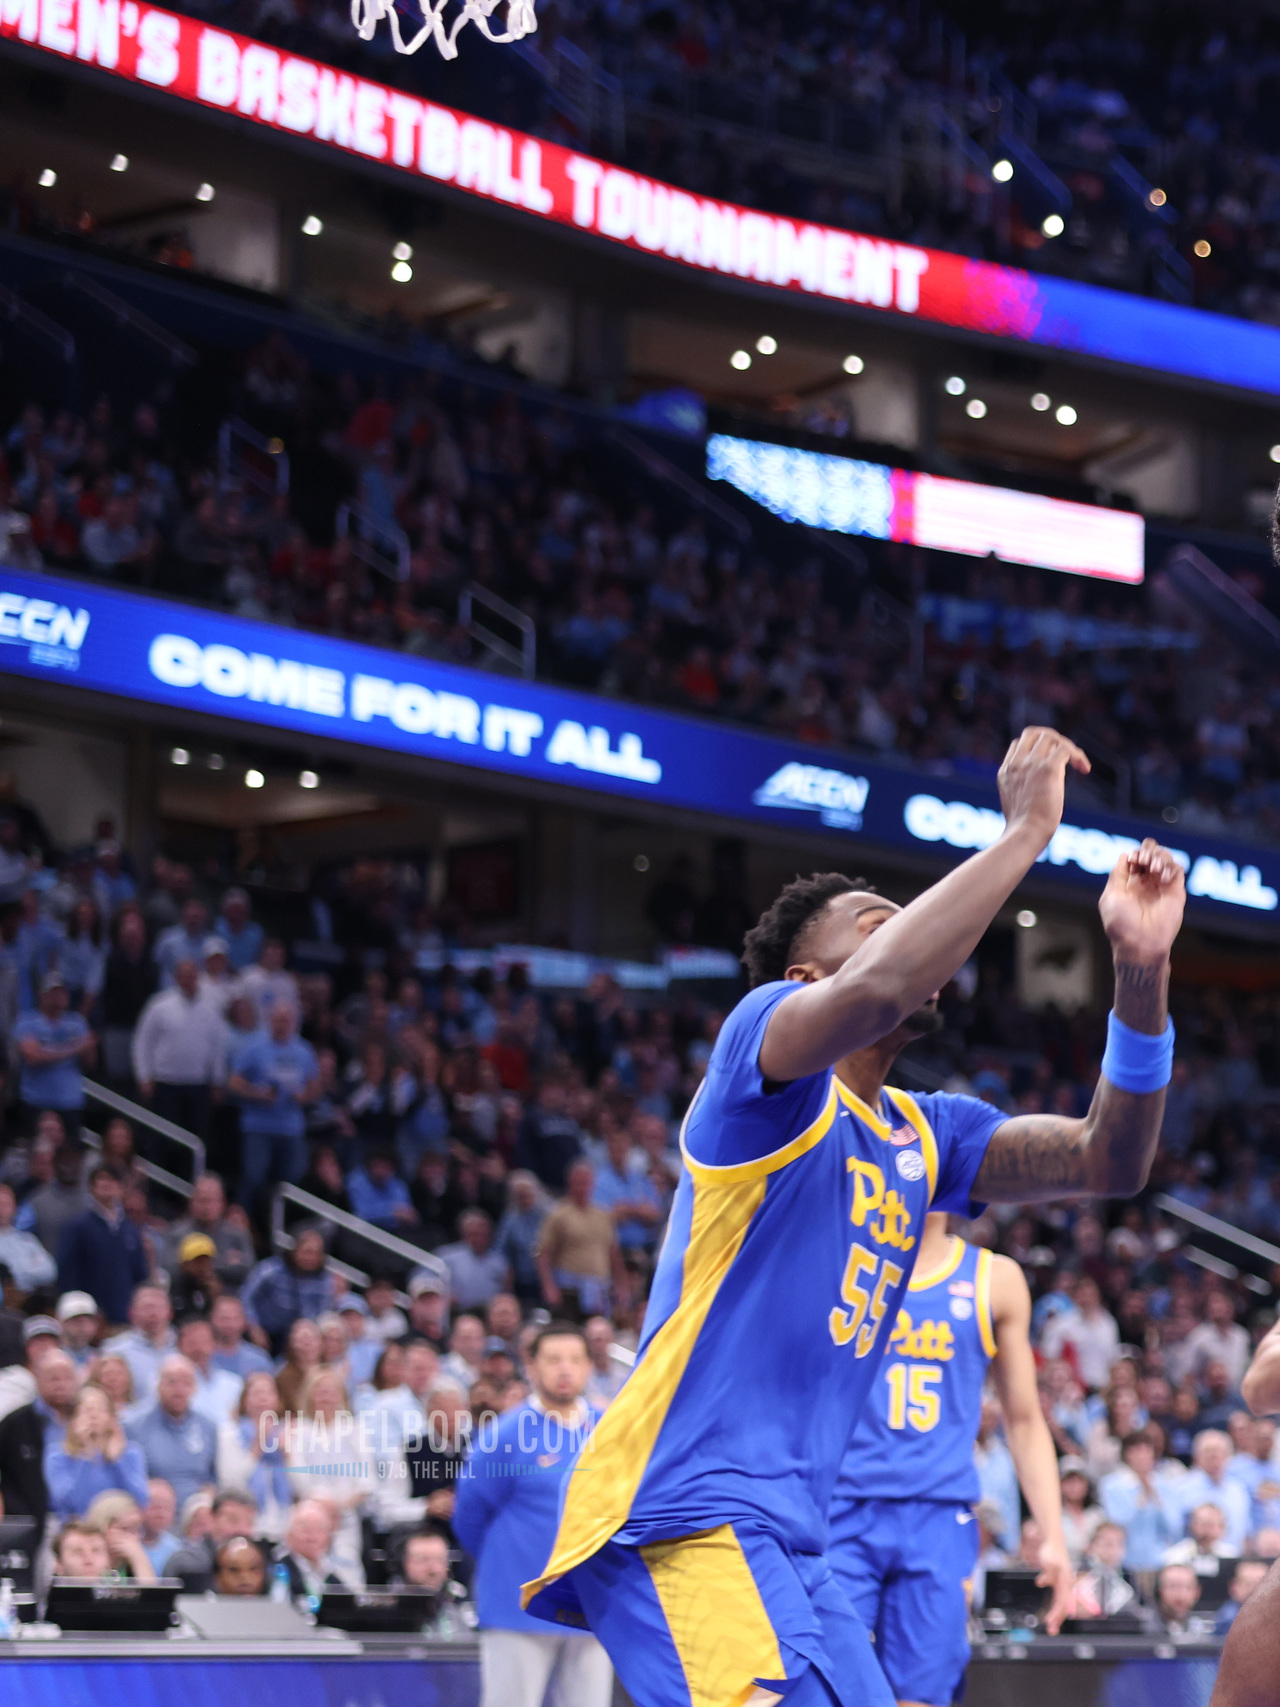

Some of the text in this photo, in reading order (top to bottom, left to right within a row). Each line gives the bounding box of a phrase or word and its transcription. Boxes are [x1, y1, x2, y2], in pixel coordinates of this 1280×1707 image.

[0, 0, 929, 314] MEN'S BASKETBALL TOURNAMENT
[149, 632, 346, 719] COME
[351, 673, 480, 745] FOR
[483, 703, 544, 758] IT
[545, 718, 662, 785] ALL
[1187, 854, 1279, 911] ALL
[846, 1154, 915, 1252] Pitt
[829, 1242, 904, 1358] 55
[885, 1362, 943, 1433] 15
